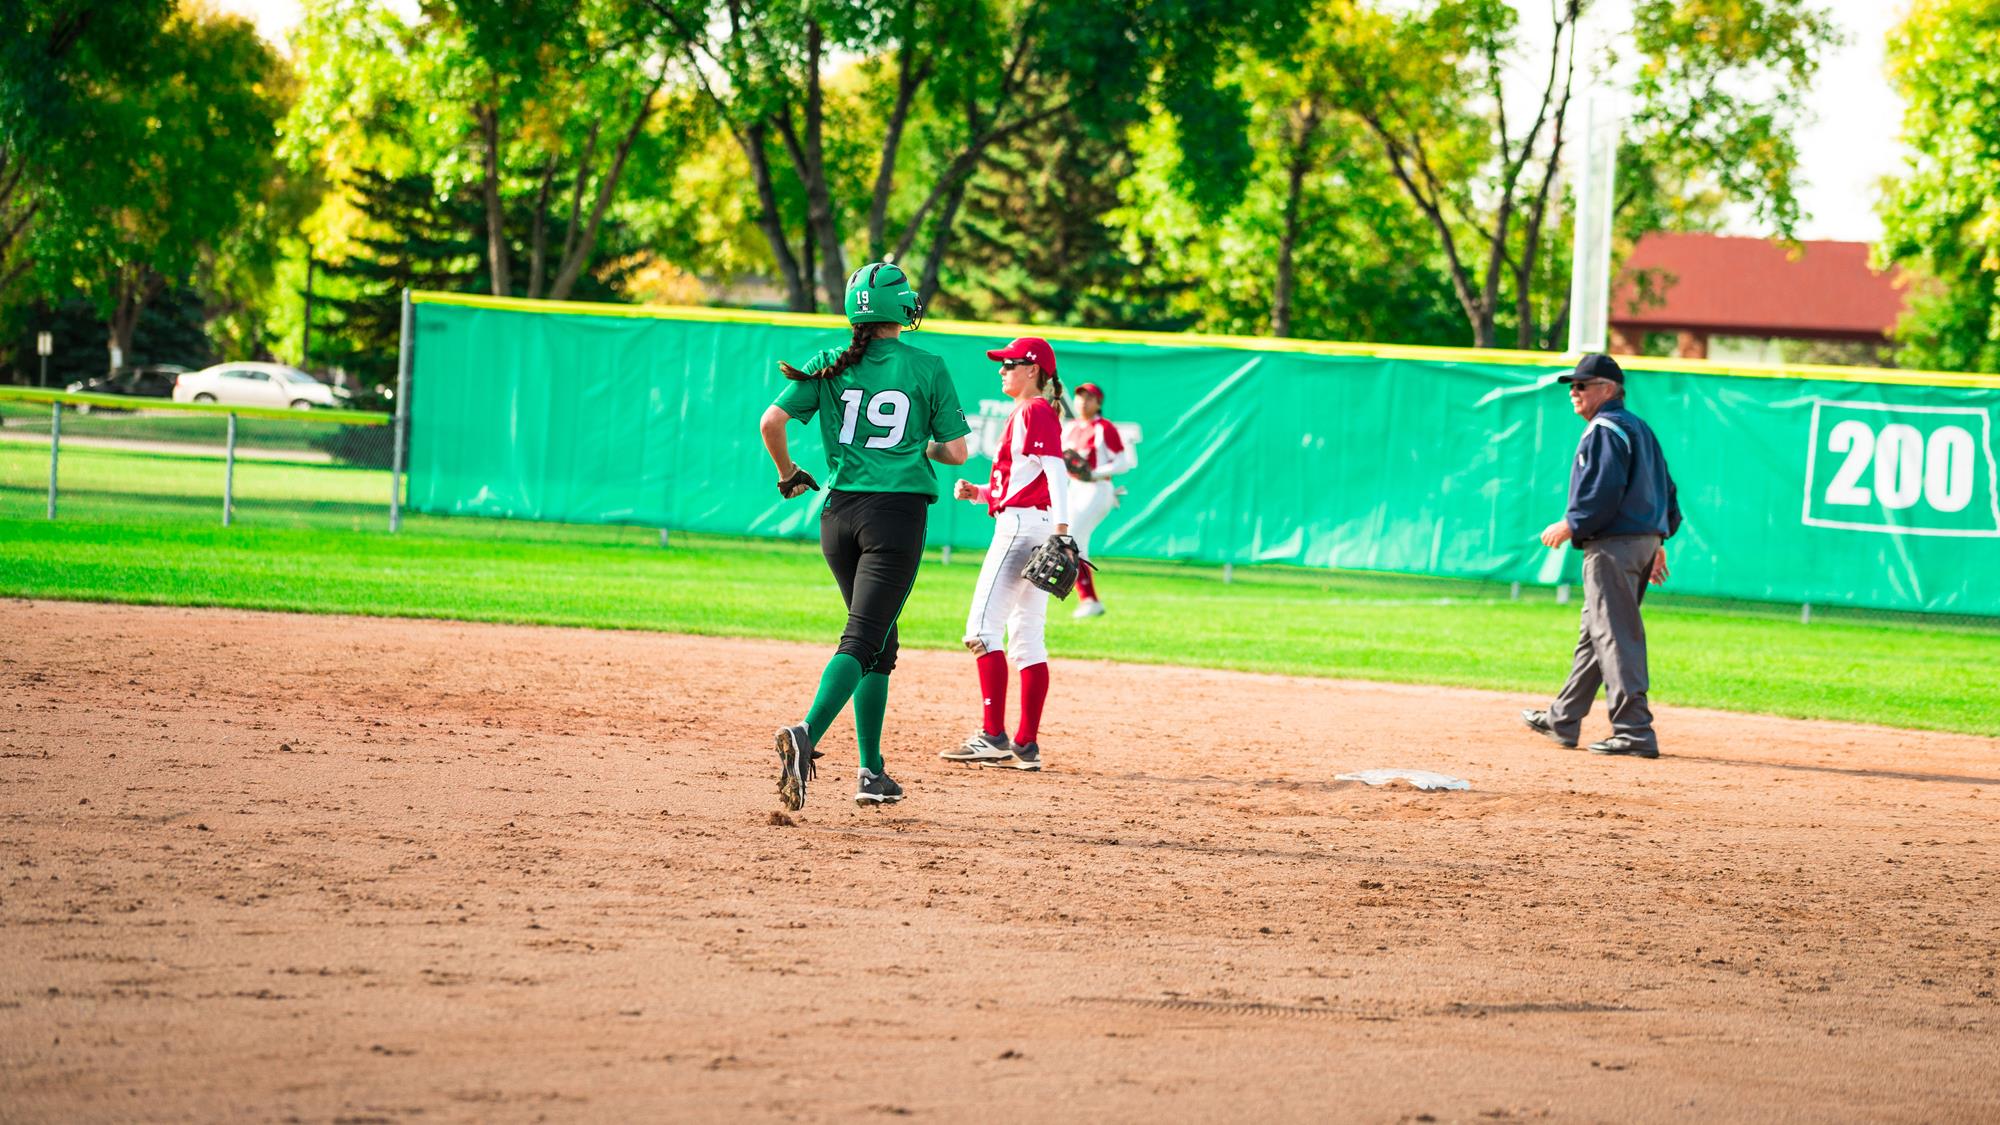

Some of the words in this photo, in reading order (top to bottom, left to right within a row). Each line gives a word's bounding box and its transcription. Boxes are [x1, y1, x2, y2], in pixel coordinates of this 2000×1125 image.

[856, 290, 869, 304] 19
[838, 387, 911, 449] 19
[991, 469, 1003, 498] 3
[1824, 419, 1976, 513] 200
